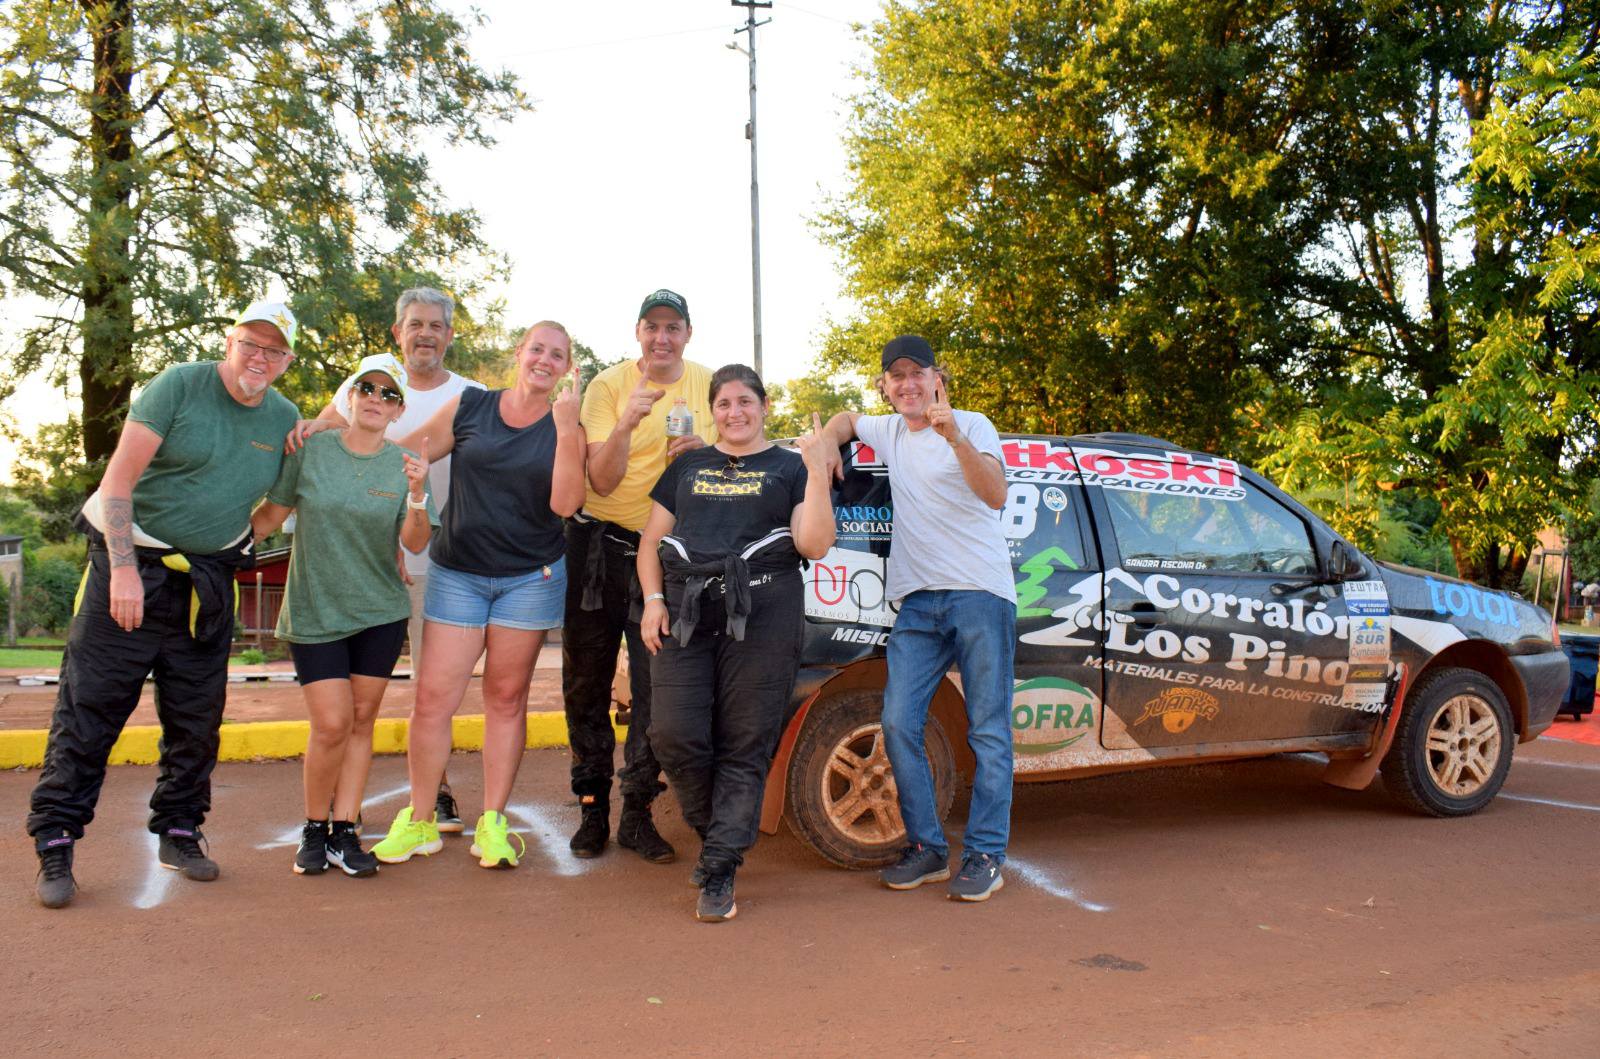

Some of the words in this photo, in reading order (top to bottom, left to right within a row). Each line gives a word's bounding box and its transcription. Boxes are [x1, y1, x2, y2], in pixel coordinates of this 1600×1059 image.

[1001, 442, 1236, 487] tkoski
[1004, 468, 1245, 498] ECTIFICACIONES
[831, 506, 891, 521] VARRO
[1125, 559, 1160, 568] SANDRA
[1161, 560, 1194, 569] ASCONA
[805, 607, 850, 620] ORAMOS
[1355, 634, 1385, 645] SUR
[1082, 655, 1200, 685] MATERIALES
[1200, 675, 1244, 693] PARA
[1247, 684, 1268, 696] LA
[1011, 704, 1094, 730] OFRA
